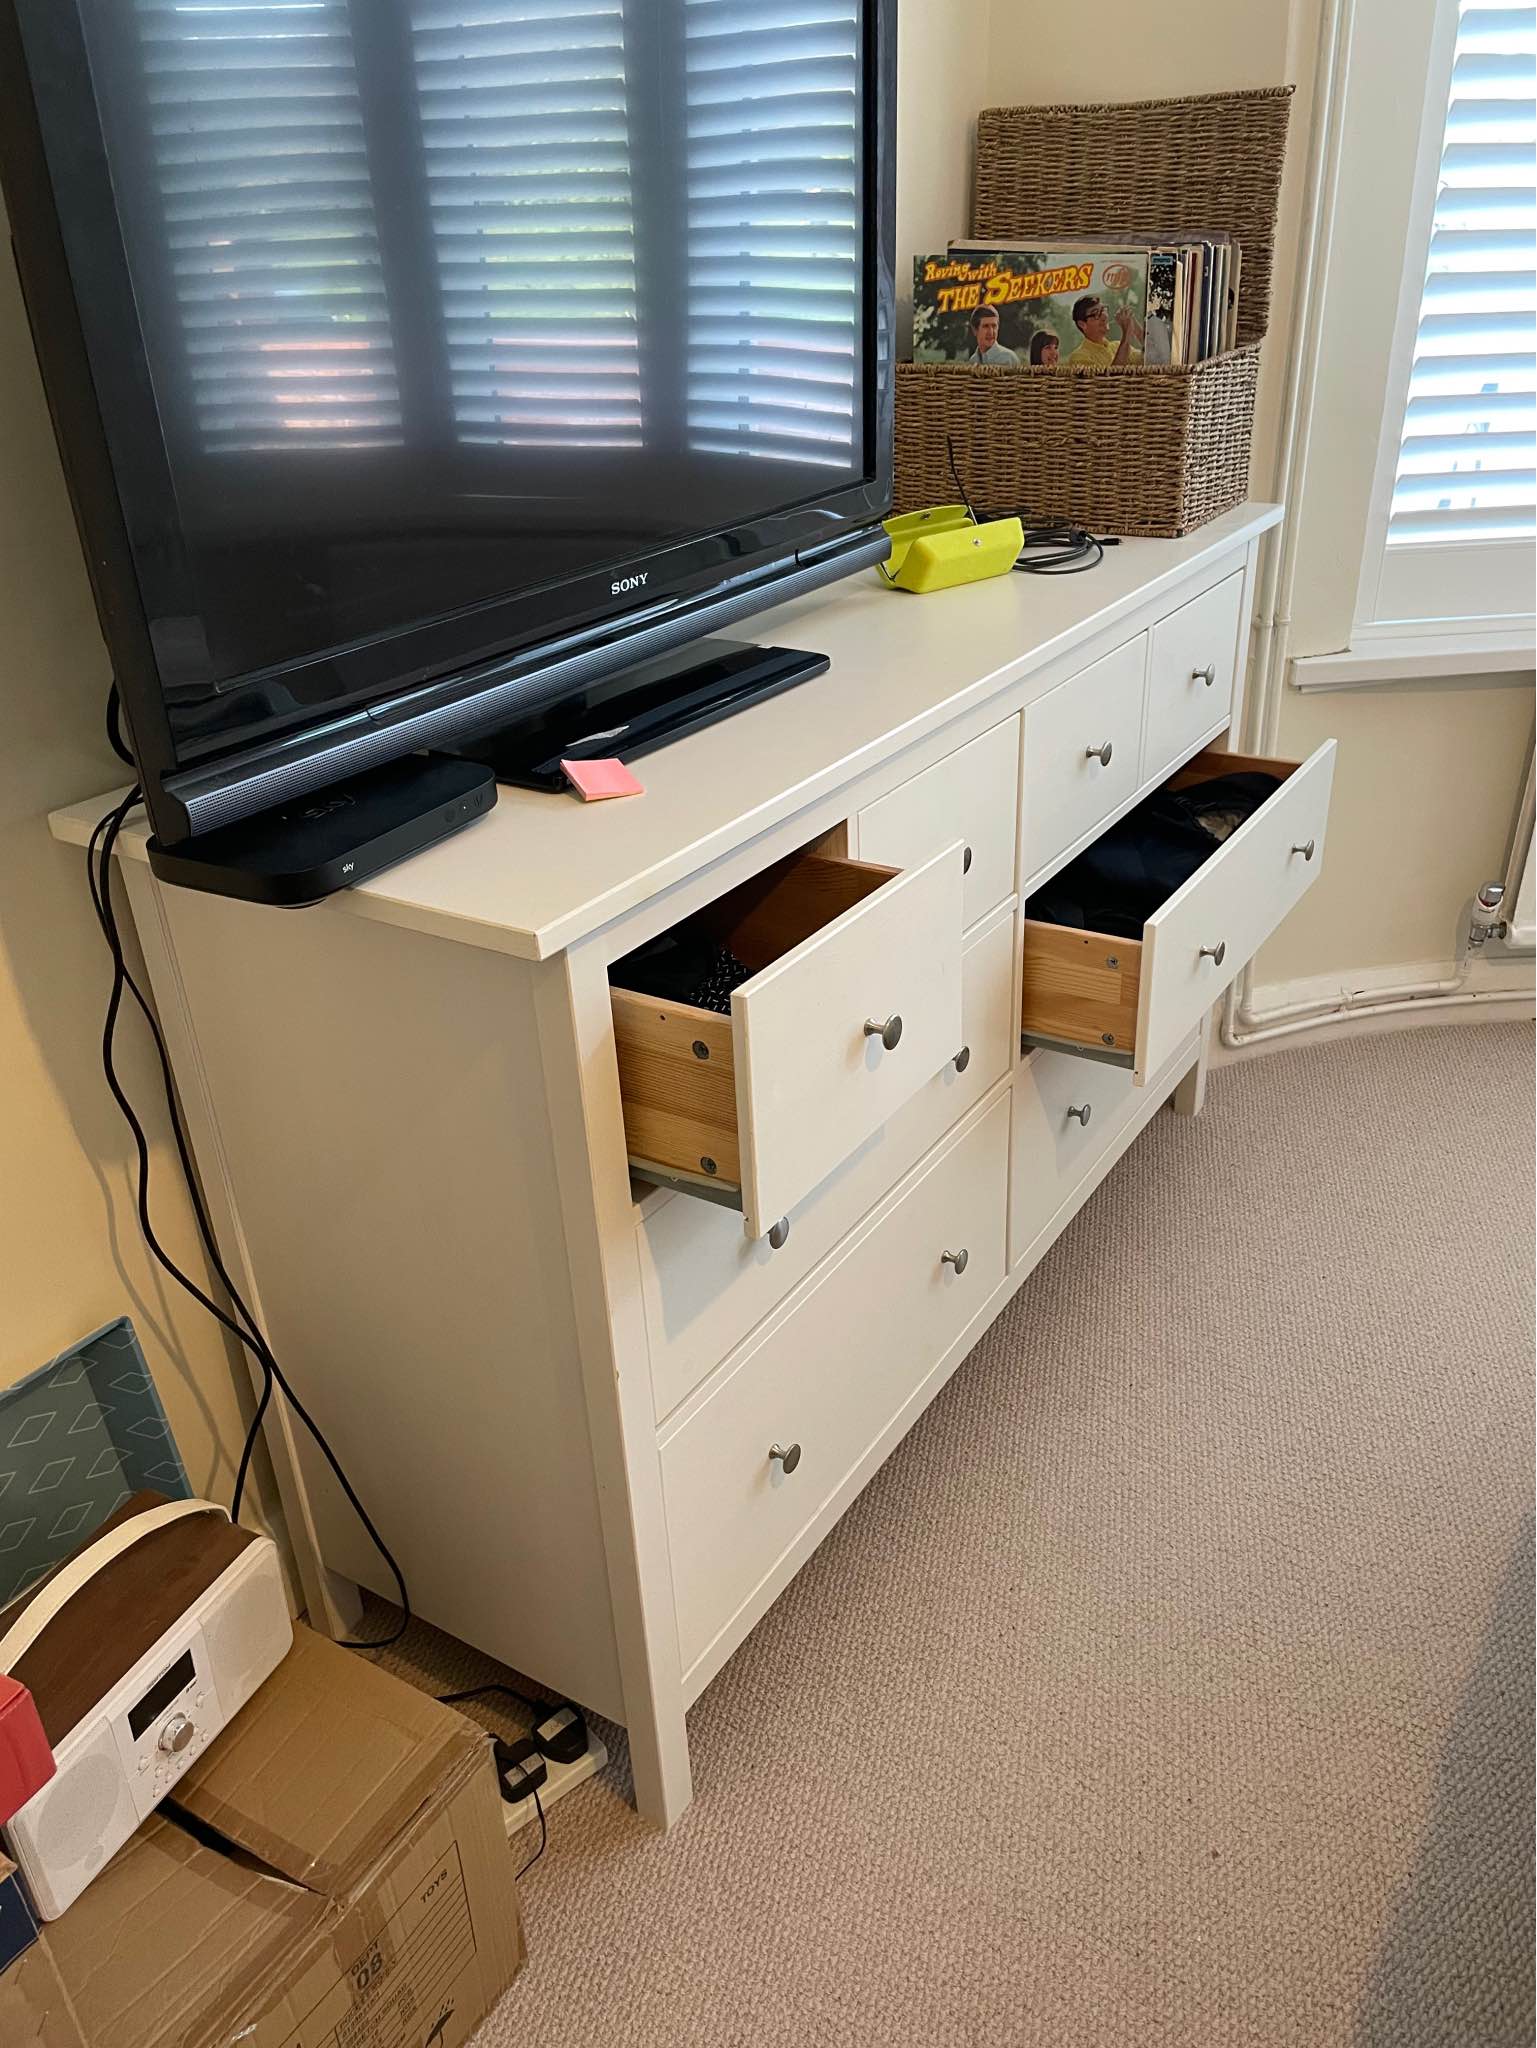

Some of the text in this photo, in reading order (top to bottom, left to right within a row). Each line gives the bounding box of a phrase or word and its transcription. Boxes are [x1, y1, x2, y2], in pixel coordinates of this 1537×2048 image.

[924, 260, 998, 283] Roving with
[937, 284, 980, 313] THE
[611, 572, 649, 595] SONY
[342, 862, 354, 874] sky
[420, 1869, 448, 1903] TOYS
[351, 1940, 380, 1976] DEPT
[356, 1952, 382, 1990] 08
